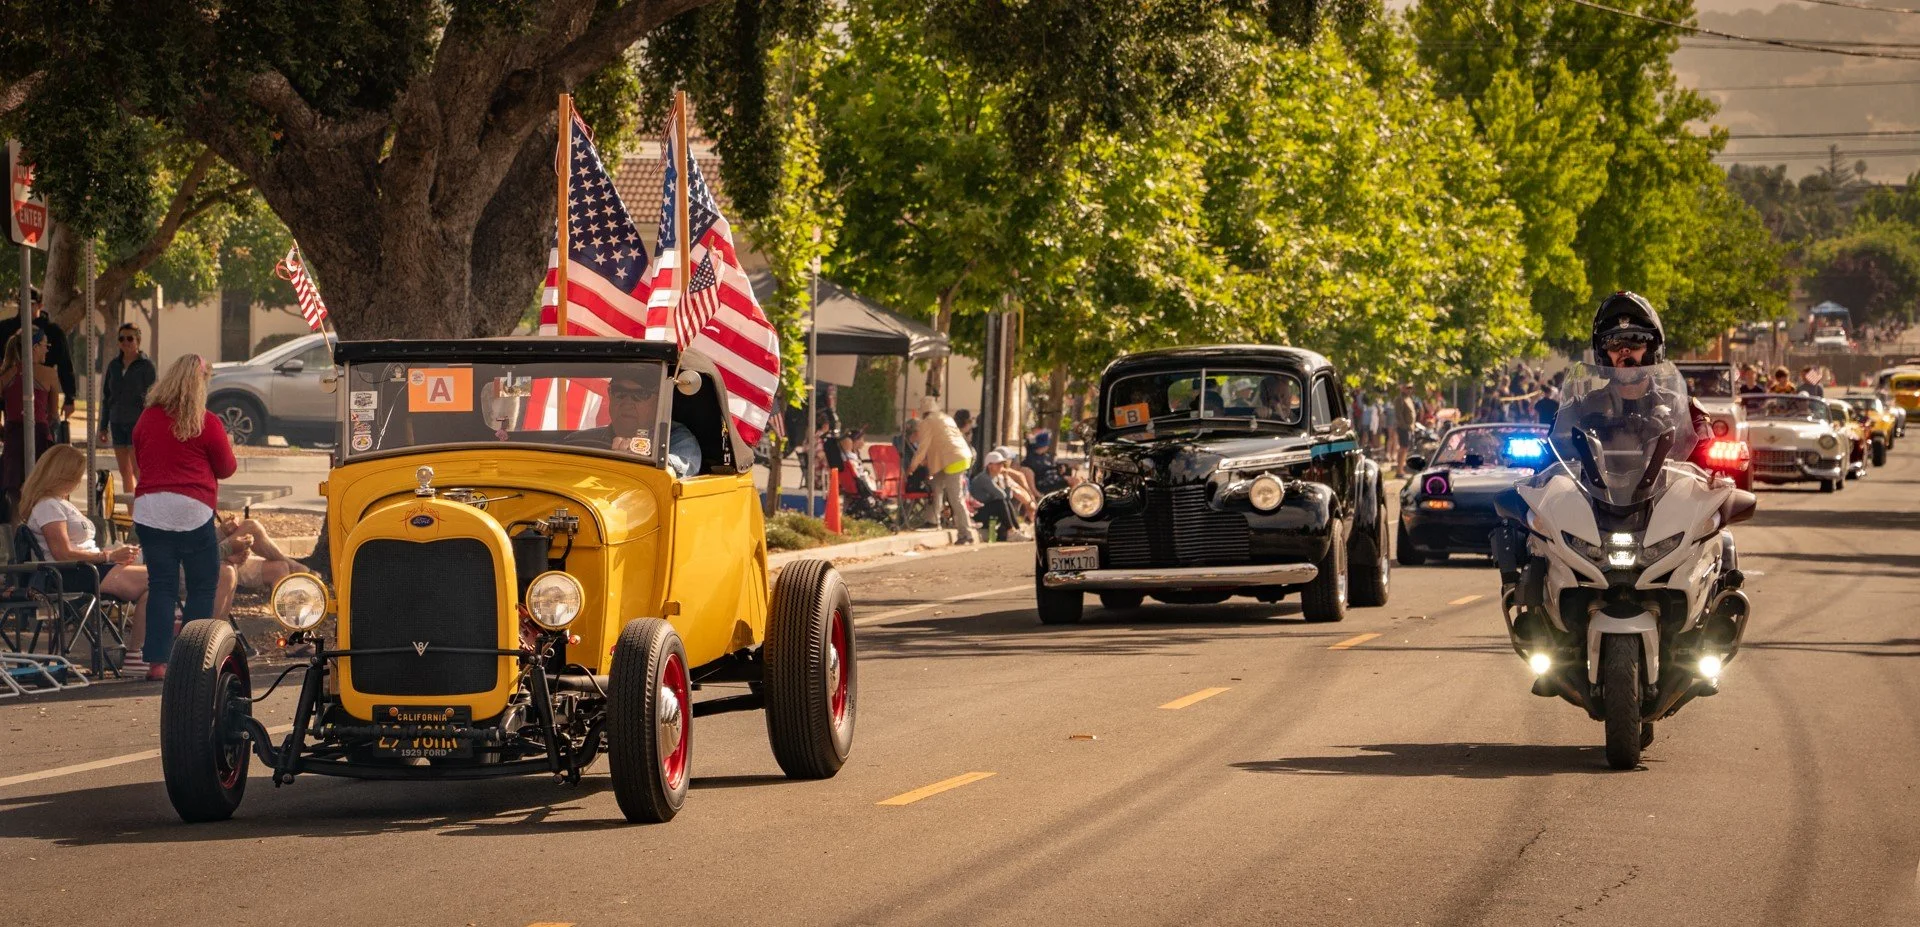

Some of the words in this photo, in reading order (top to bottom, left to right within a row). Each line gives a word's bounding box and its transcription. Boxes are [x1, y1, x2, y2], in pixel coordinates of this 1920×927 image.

[20, 207, 42, 228] ENTER
[429, 377, 451, 401] A
[1127, 410, 1138, 423] B
[1051, 556, 1096, 570] 5YMK170
[397, 713, 447, 722] CALIFORNIA
[401, 749, 422, 757] 1929
[423, 749, 447, 757] FORD
